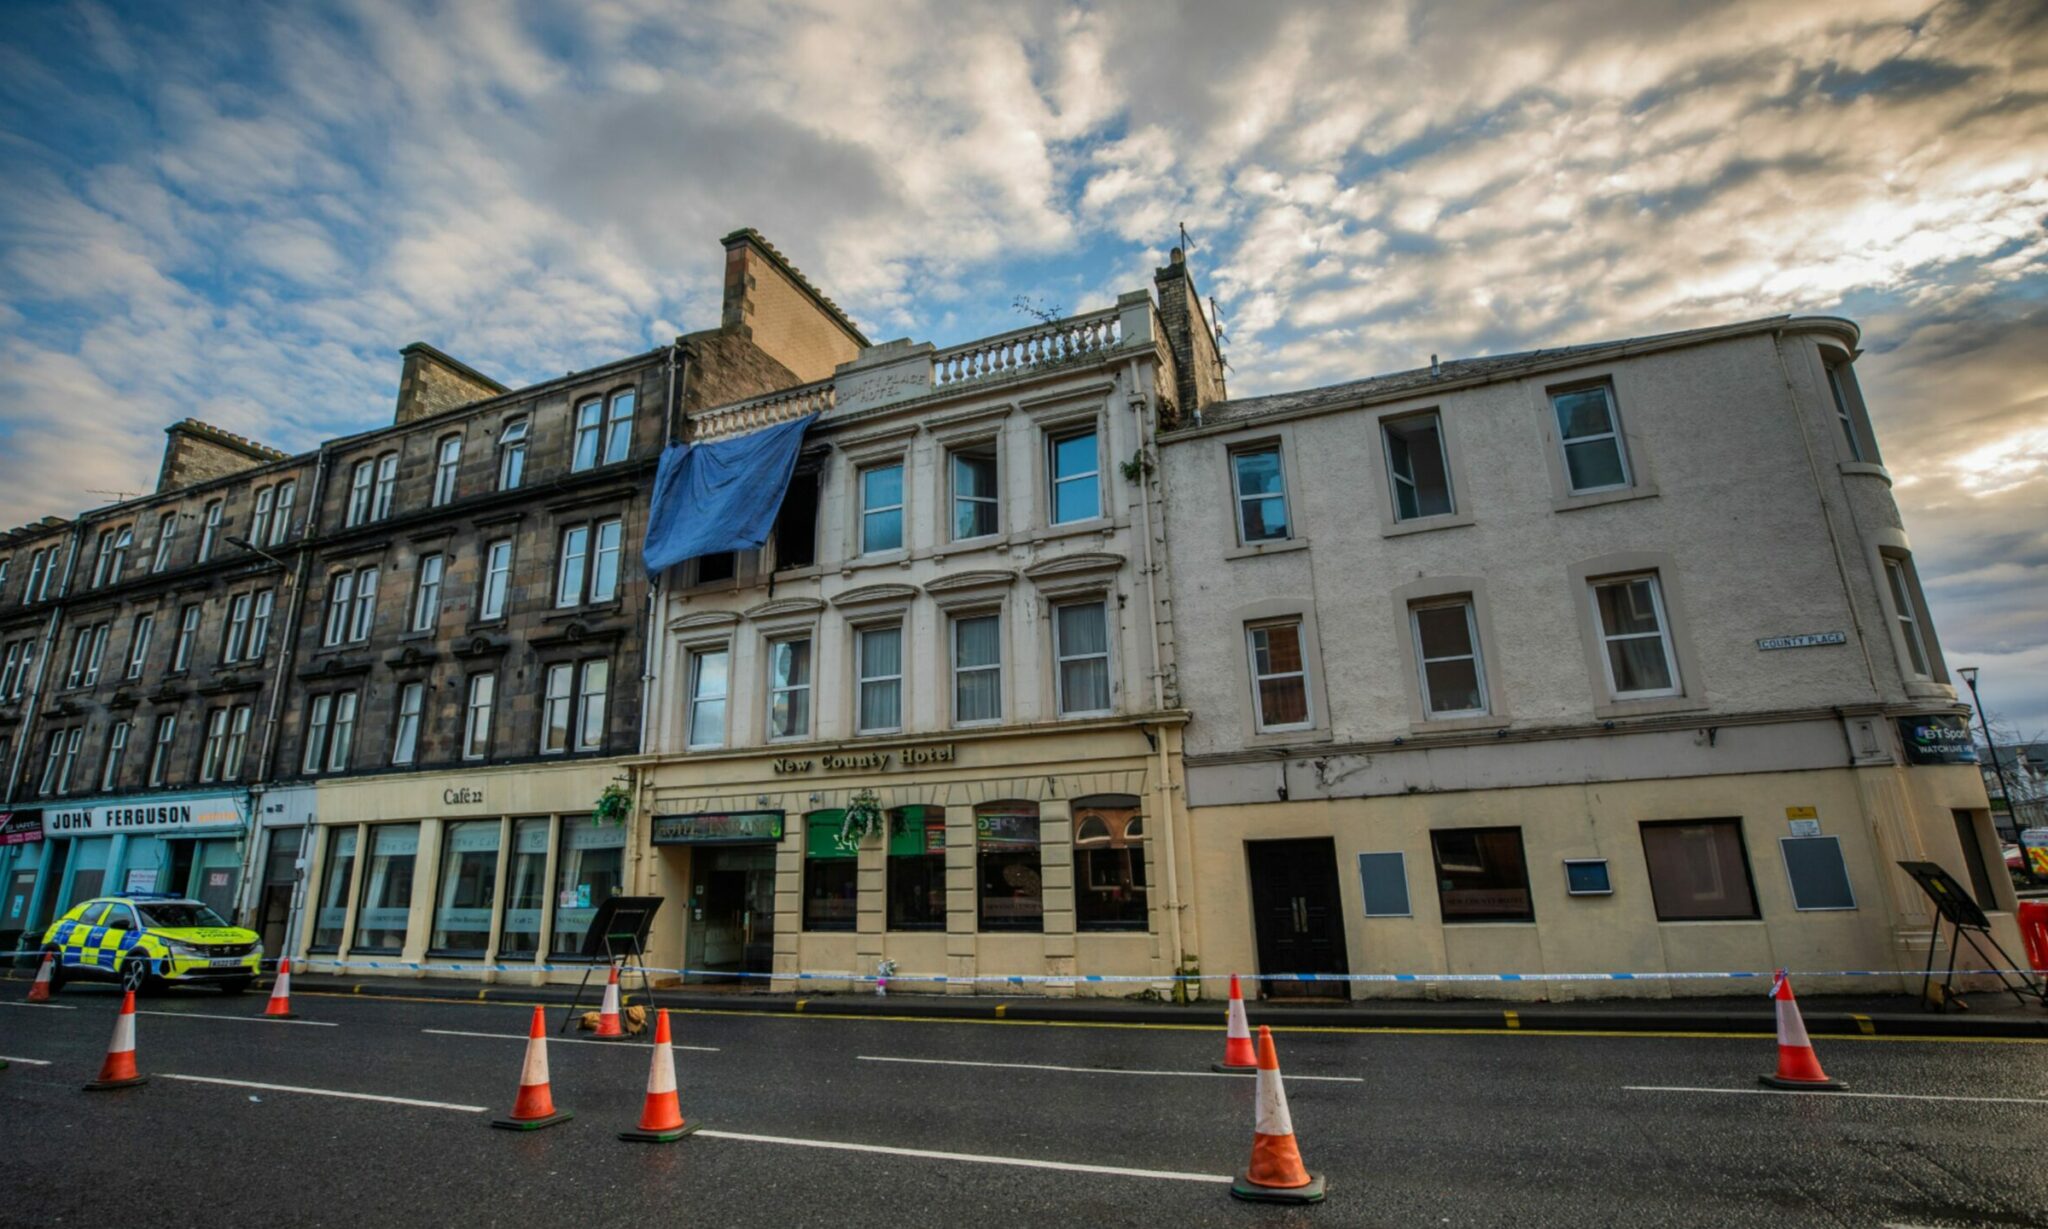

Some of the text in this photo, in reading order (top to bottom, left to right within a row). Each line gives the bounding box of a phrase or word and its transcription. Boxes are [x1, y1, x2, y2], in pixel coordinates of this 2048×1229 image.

[1761, 634, 1841, 649] COUNTY PLACE
[1924, 729, 1943, 740] BT
[774, 744, 956, 774] New County Hotel
[472, 791, 482, 804] 22
[52, 811, 92, 829] JOHN
[106, 805, 191, 827] FERGUSON
